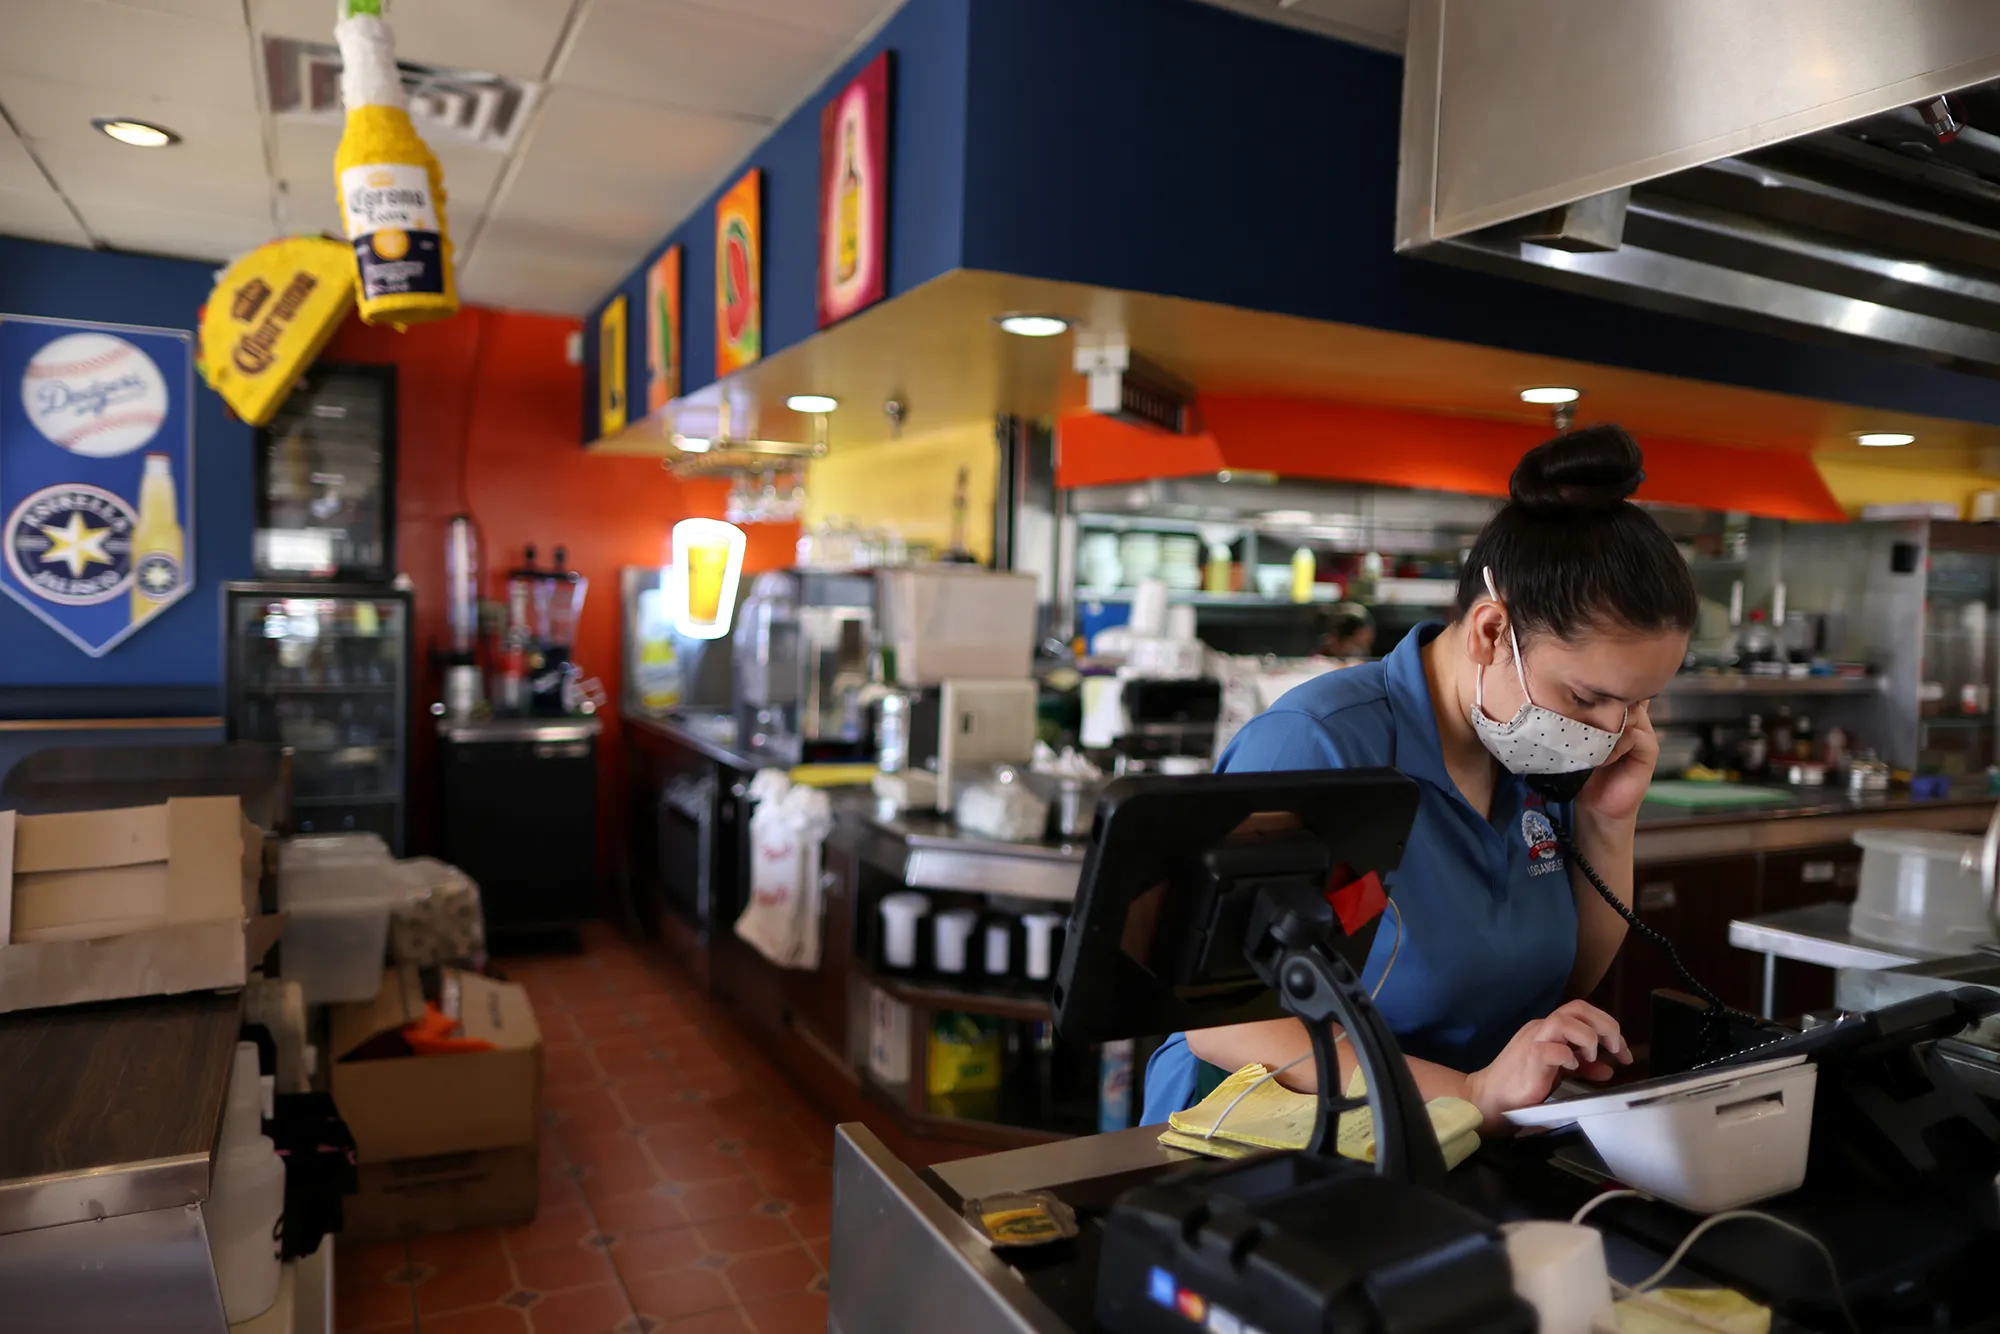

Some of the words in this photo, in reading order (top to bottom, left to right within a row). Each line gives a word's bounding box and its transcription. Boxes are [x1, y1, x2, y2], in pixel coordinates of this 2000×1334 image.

[350, 187, 425, 213] Corona
[232, 270, 318, 375] Corona
[36, 372, 147, 416] Dodgers
